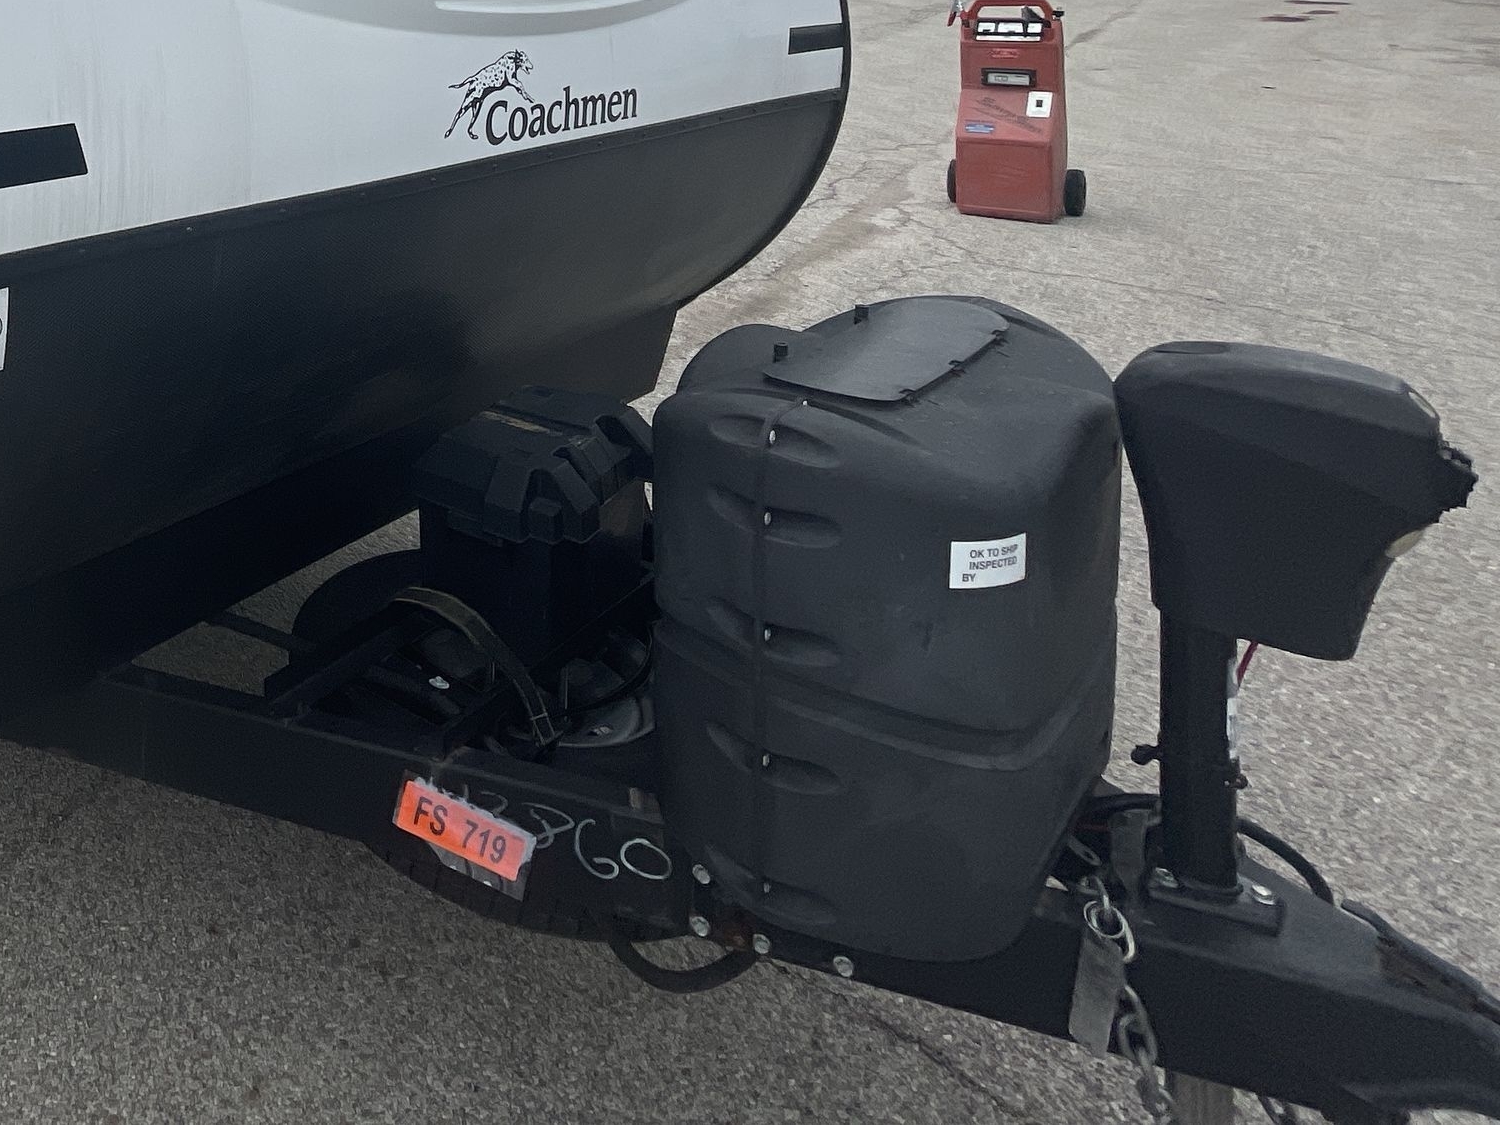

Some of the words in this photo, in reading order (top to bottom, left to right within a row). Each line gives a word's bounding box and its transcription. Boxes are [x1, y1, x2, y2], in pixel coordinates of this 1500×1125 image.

[485, 85, 638, 146] Coachmen
[970, 549, 985, 558] OK
[987, 548, 999, 557] TO
[969, 556, 1018, 570] INSPECTED
[962, 573, 976, 582] BY
[413, 796, 448, 836] FS
[460, 819, 507, 865] 719
